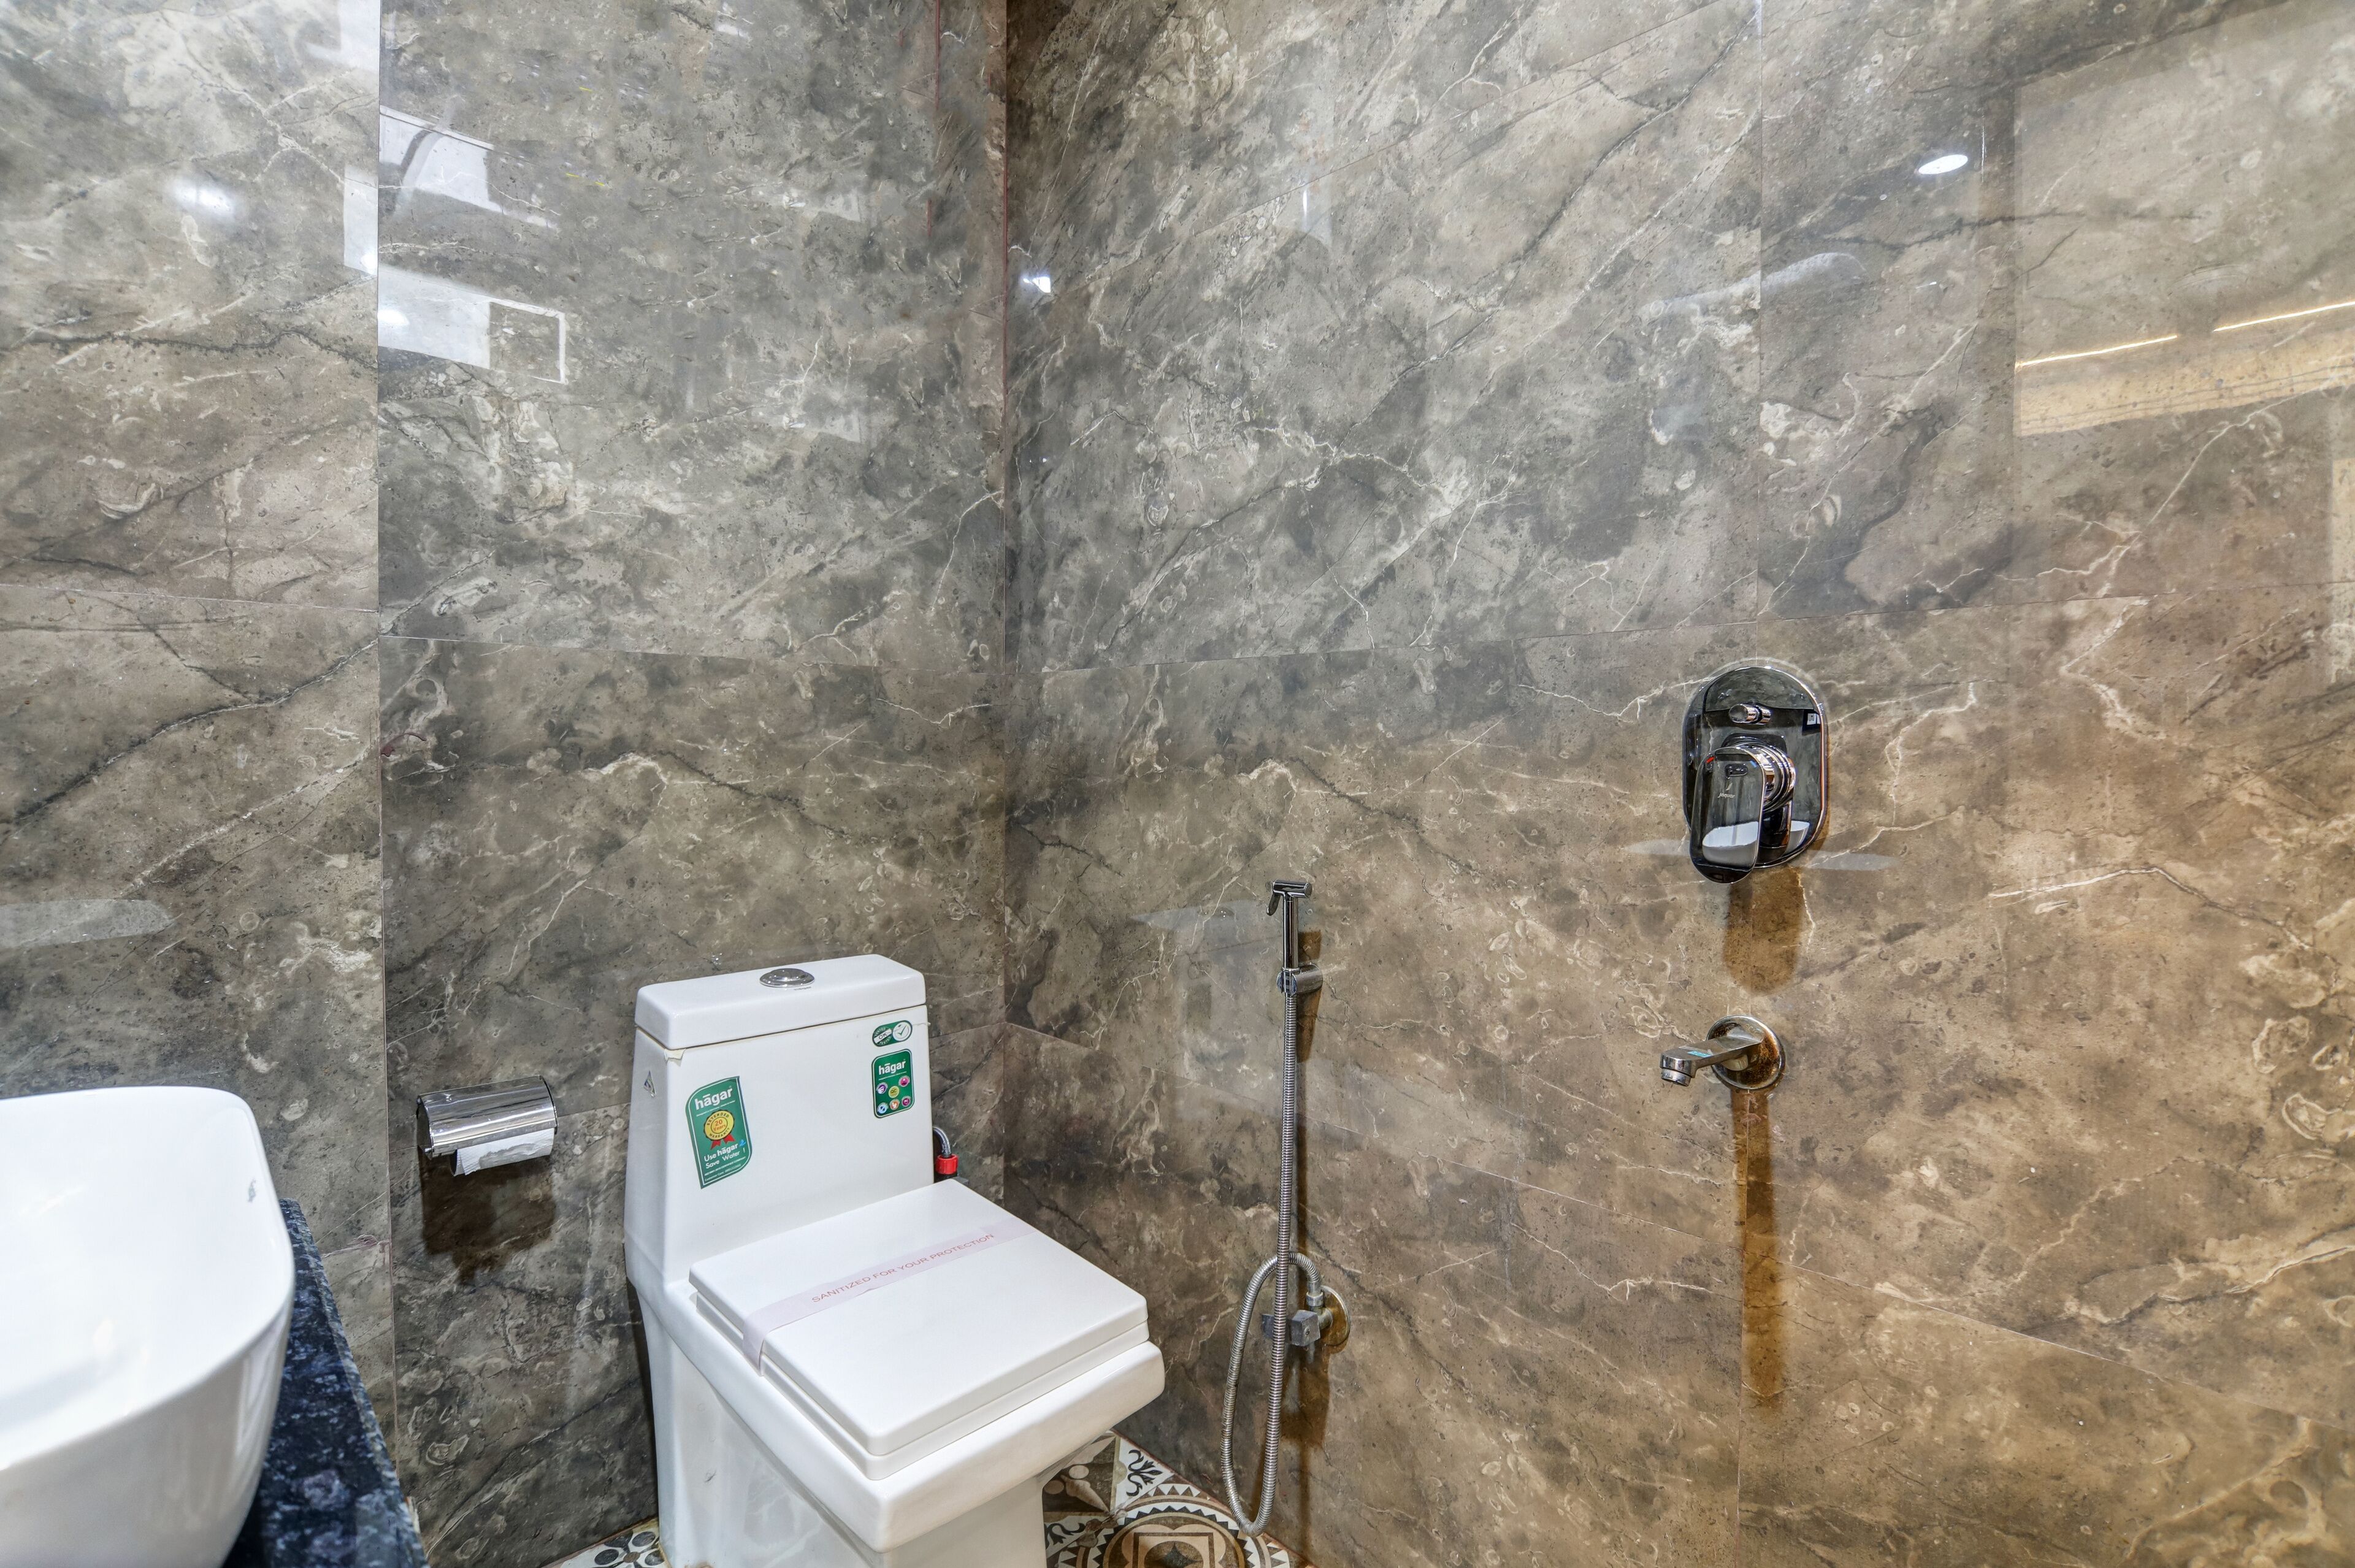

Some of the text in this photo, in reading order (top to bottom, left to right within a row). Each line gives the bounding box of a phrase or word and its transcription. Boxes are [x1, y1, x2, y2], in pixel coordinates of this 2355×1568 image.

[706, 1112, 730, 1126] EXTENDED
[709, 1127, 730, 1138] WARRANTY
[703, 1153, 717, 1161] Use
[705, 1160, 720, 1169] Save
[721, 1150, 740, 1161] Water
[811, 1233, 994, 1303] SANITIZED FOR YOUR PROTECTION
